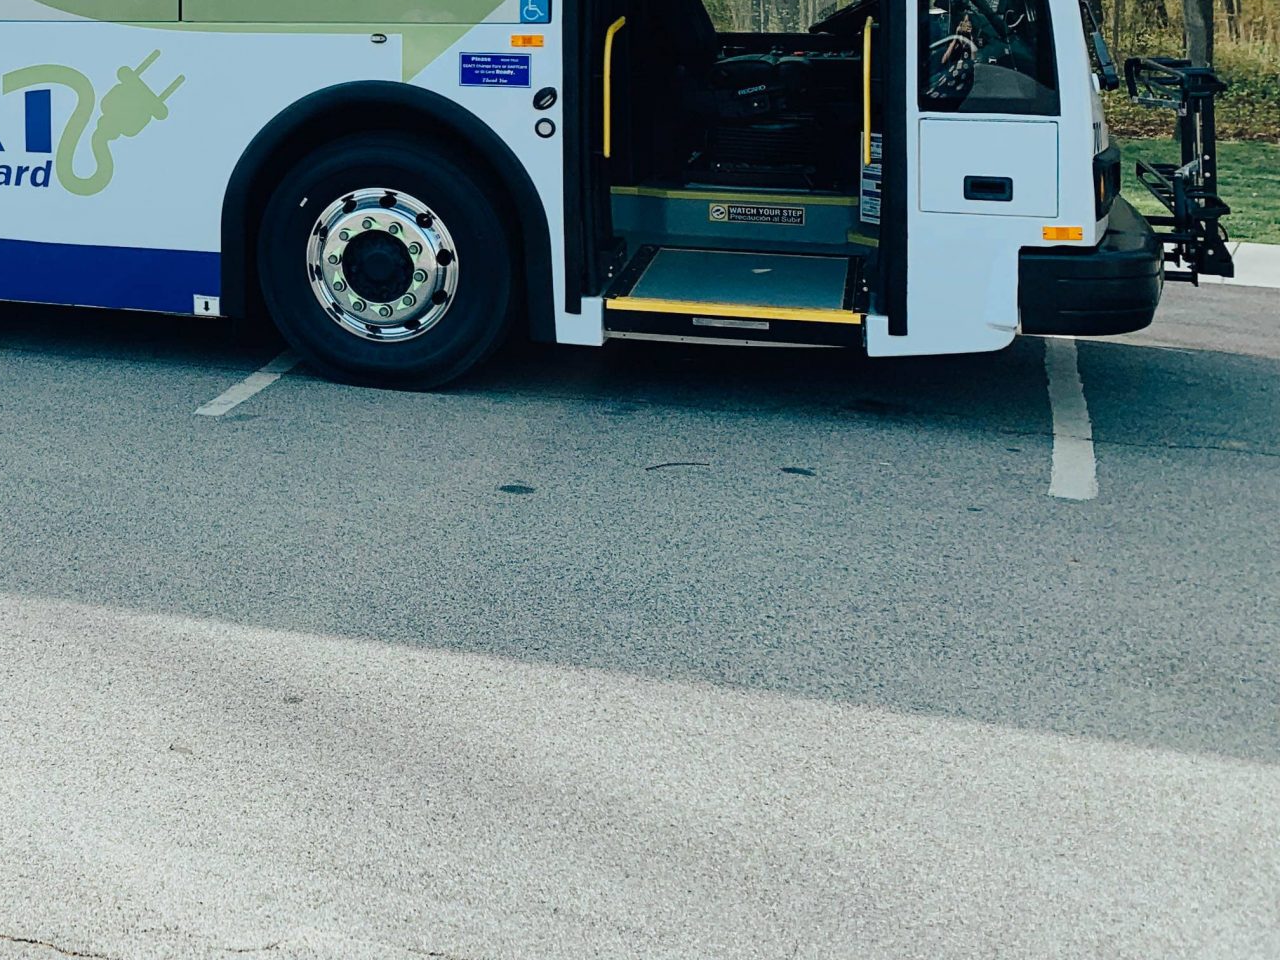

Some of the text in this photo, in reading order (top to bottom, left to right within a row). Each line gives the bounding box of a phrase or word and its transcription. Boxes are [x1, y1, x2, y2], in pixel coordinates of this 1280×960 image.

[759, 208, 781, 216] YOUR
[782, 209, 803, 218] STEP
[781, 215, 801, 223] Subir
